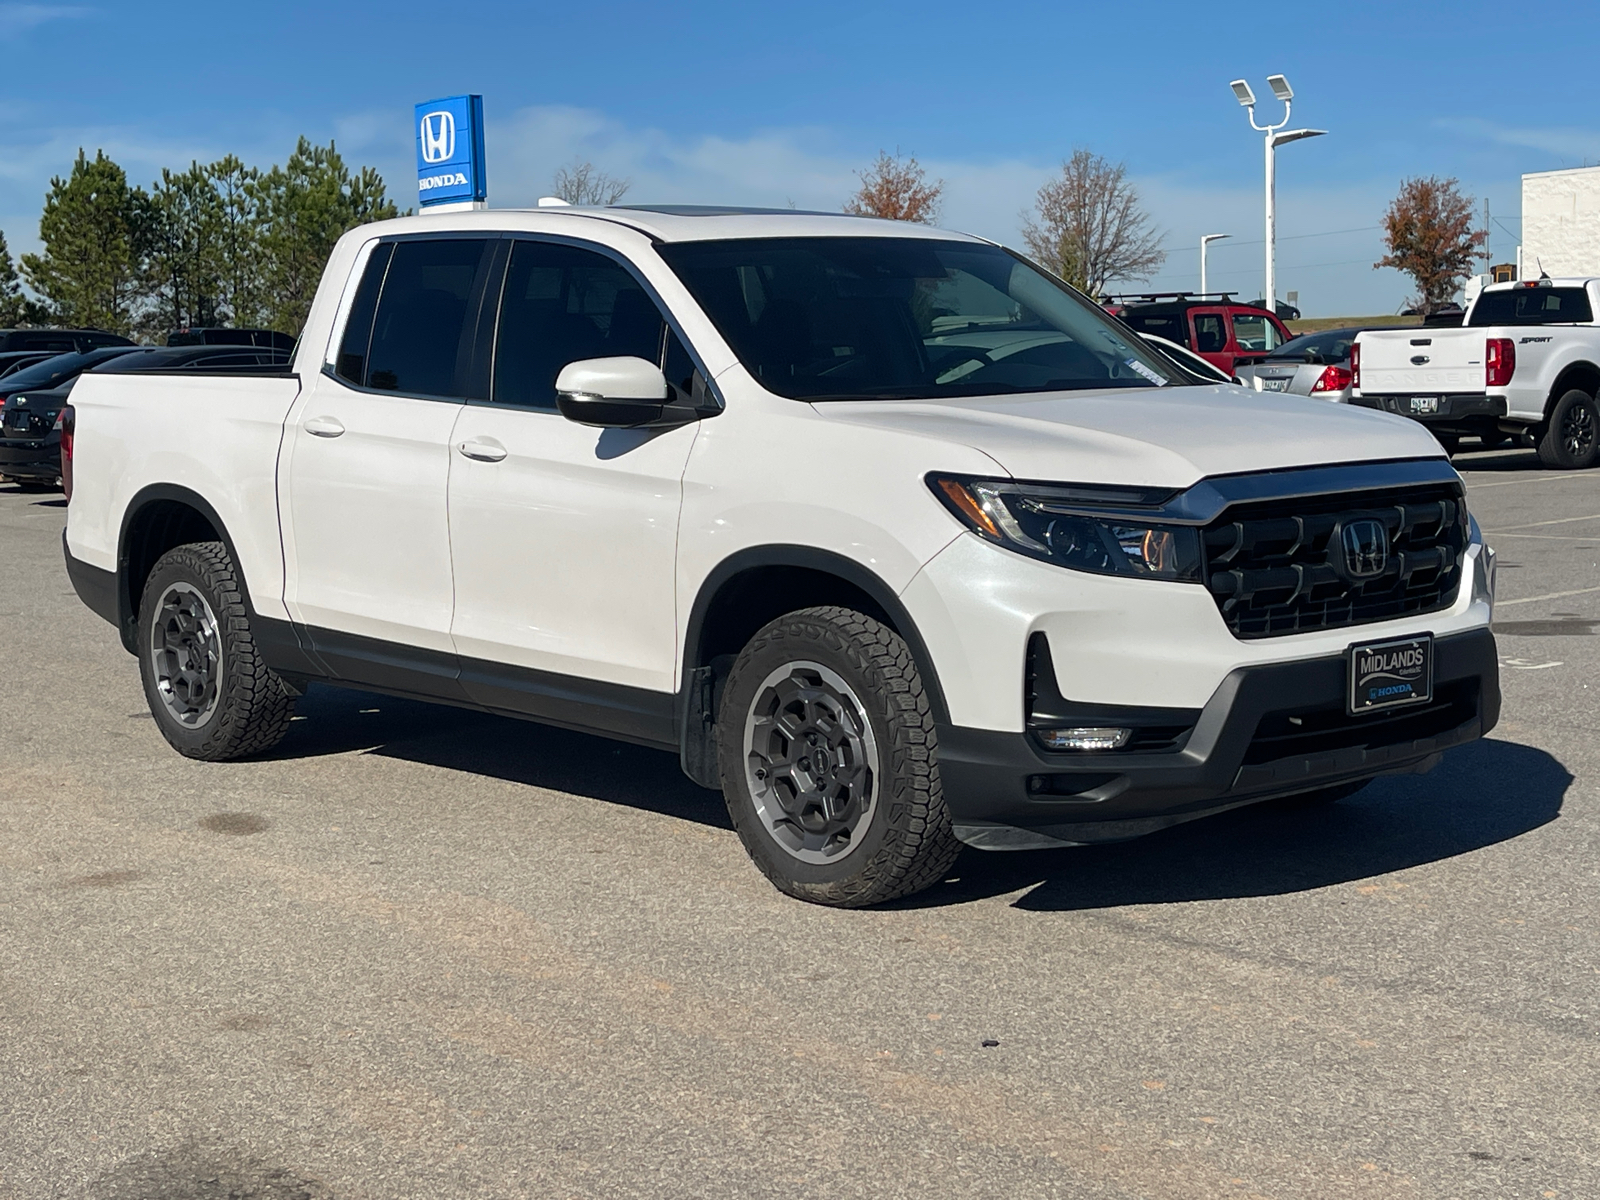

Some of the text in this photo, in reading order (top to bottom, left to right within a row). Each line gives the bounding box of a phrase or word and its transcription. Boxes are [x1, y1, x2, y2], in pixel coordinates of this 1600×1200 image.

[418, 172, 468, 190] HONDA
[1519, 336, 1553, 344] SPORT
[1365, 373, 1482, 385] RANGER
[1360, 648, 1424, 674] MIDLANDS
[1377, 683, 1413, 697] HONDA
